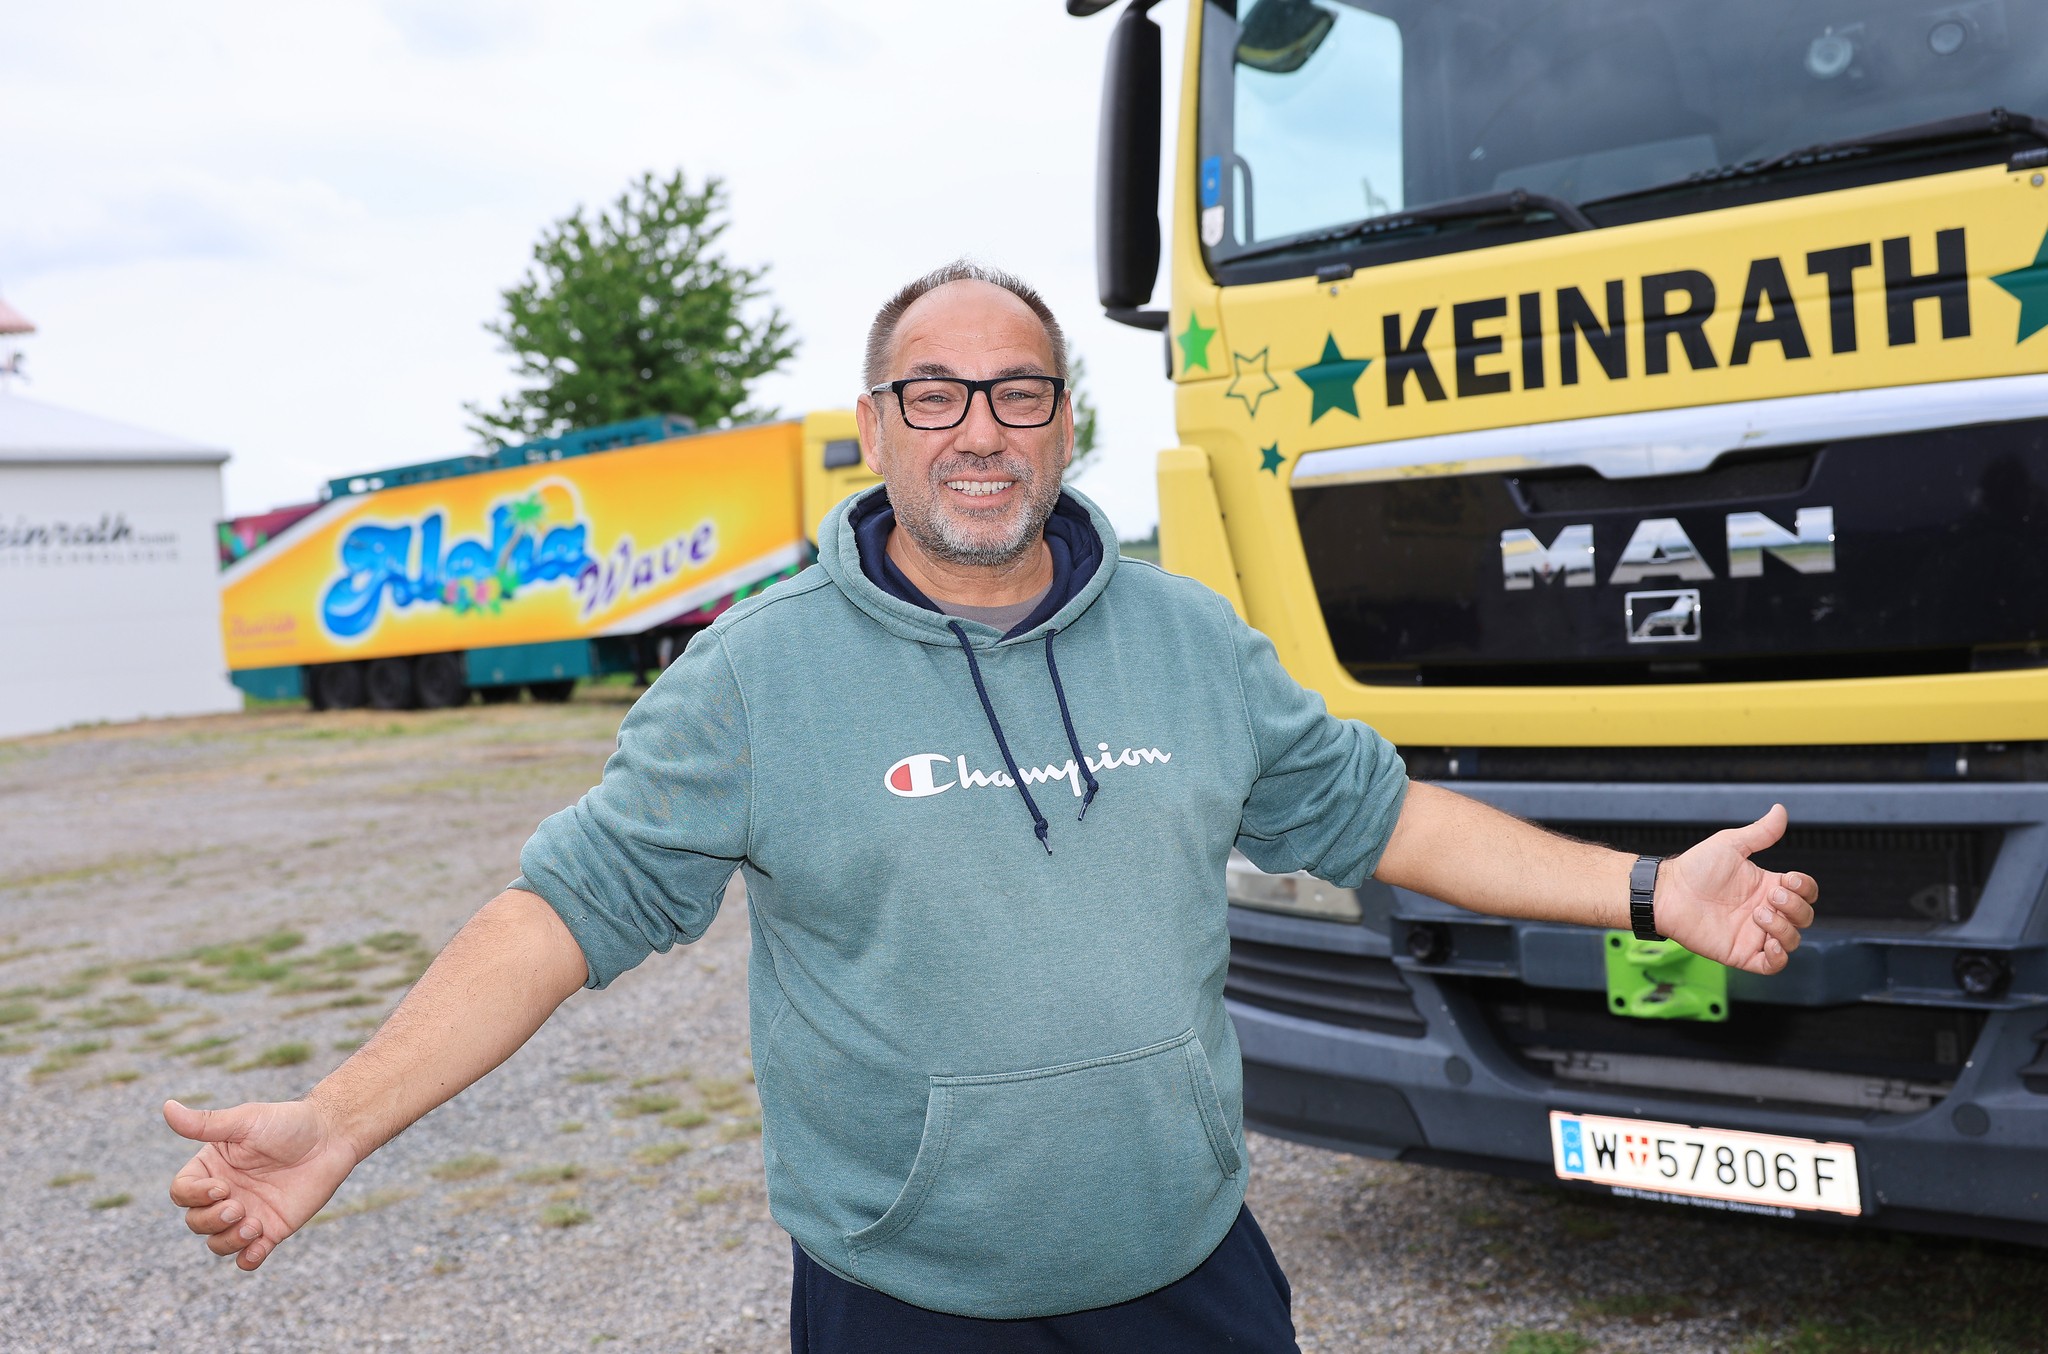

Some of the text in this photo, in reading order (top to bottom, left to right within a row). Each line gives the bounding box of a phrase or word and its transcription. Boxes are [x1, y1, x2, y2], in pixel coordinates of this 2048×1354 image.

[1383, 227, 1972, 408] KEINRATH
[0, 511, 134, 547] einrath
[320, 502, 594, 637] Aloha
[574, 523, 715, 618] Wave
[1501, 505, 1836, 590] MAN
[884, 742, 1172, 798] Champion
[1591, 1131, 1836, 1197] W 57806 F
